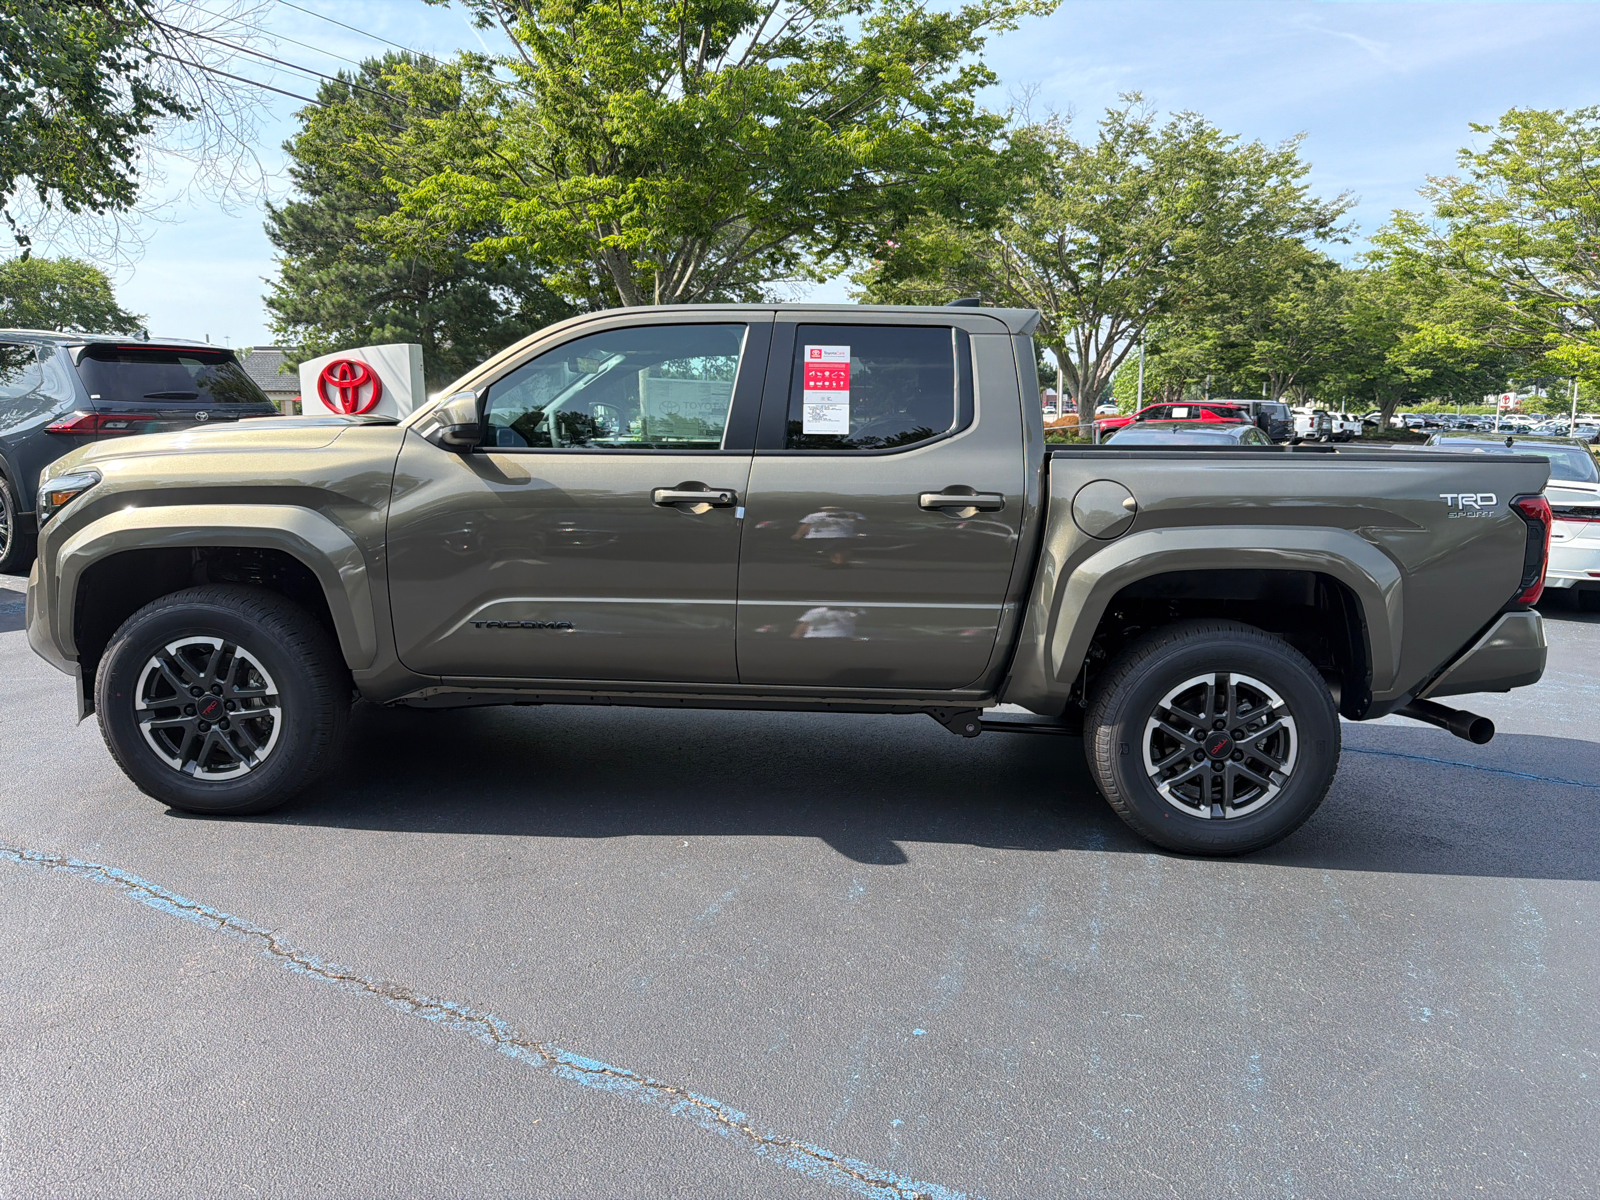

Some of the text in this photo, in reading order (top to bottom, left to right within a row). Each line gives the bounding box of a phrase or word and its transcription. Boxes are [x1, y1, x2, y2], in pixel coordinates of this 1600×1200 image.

[1439, 493, 1498, 510] TRD
[1447, 511, 1495, 519] SPORT
[469, 620, 574, 630] TACOMA
[202, 700, 218, 715] TRD
